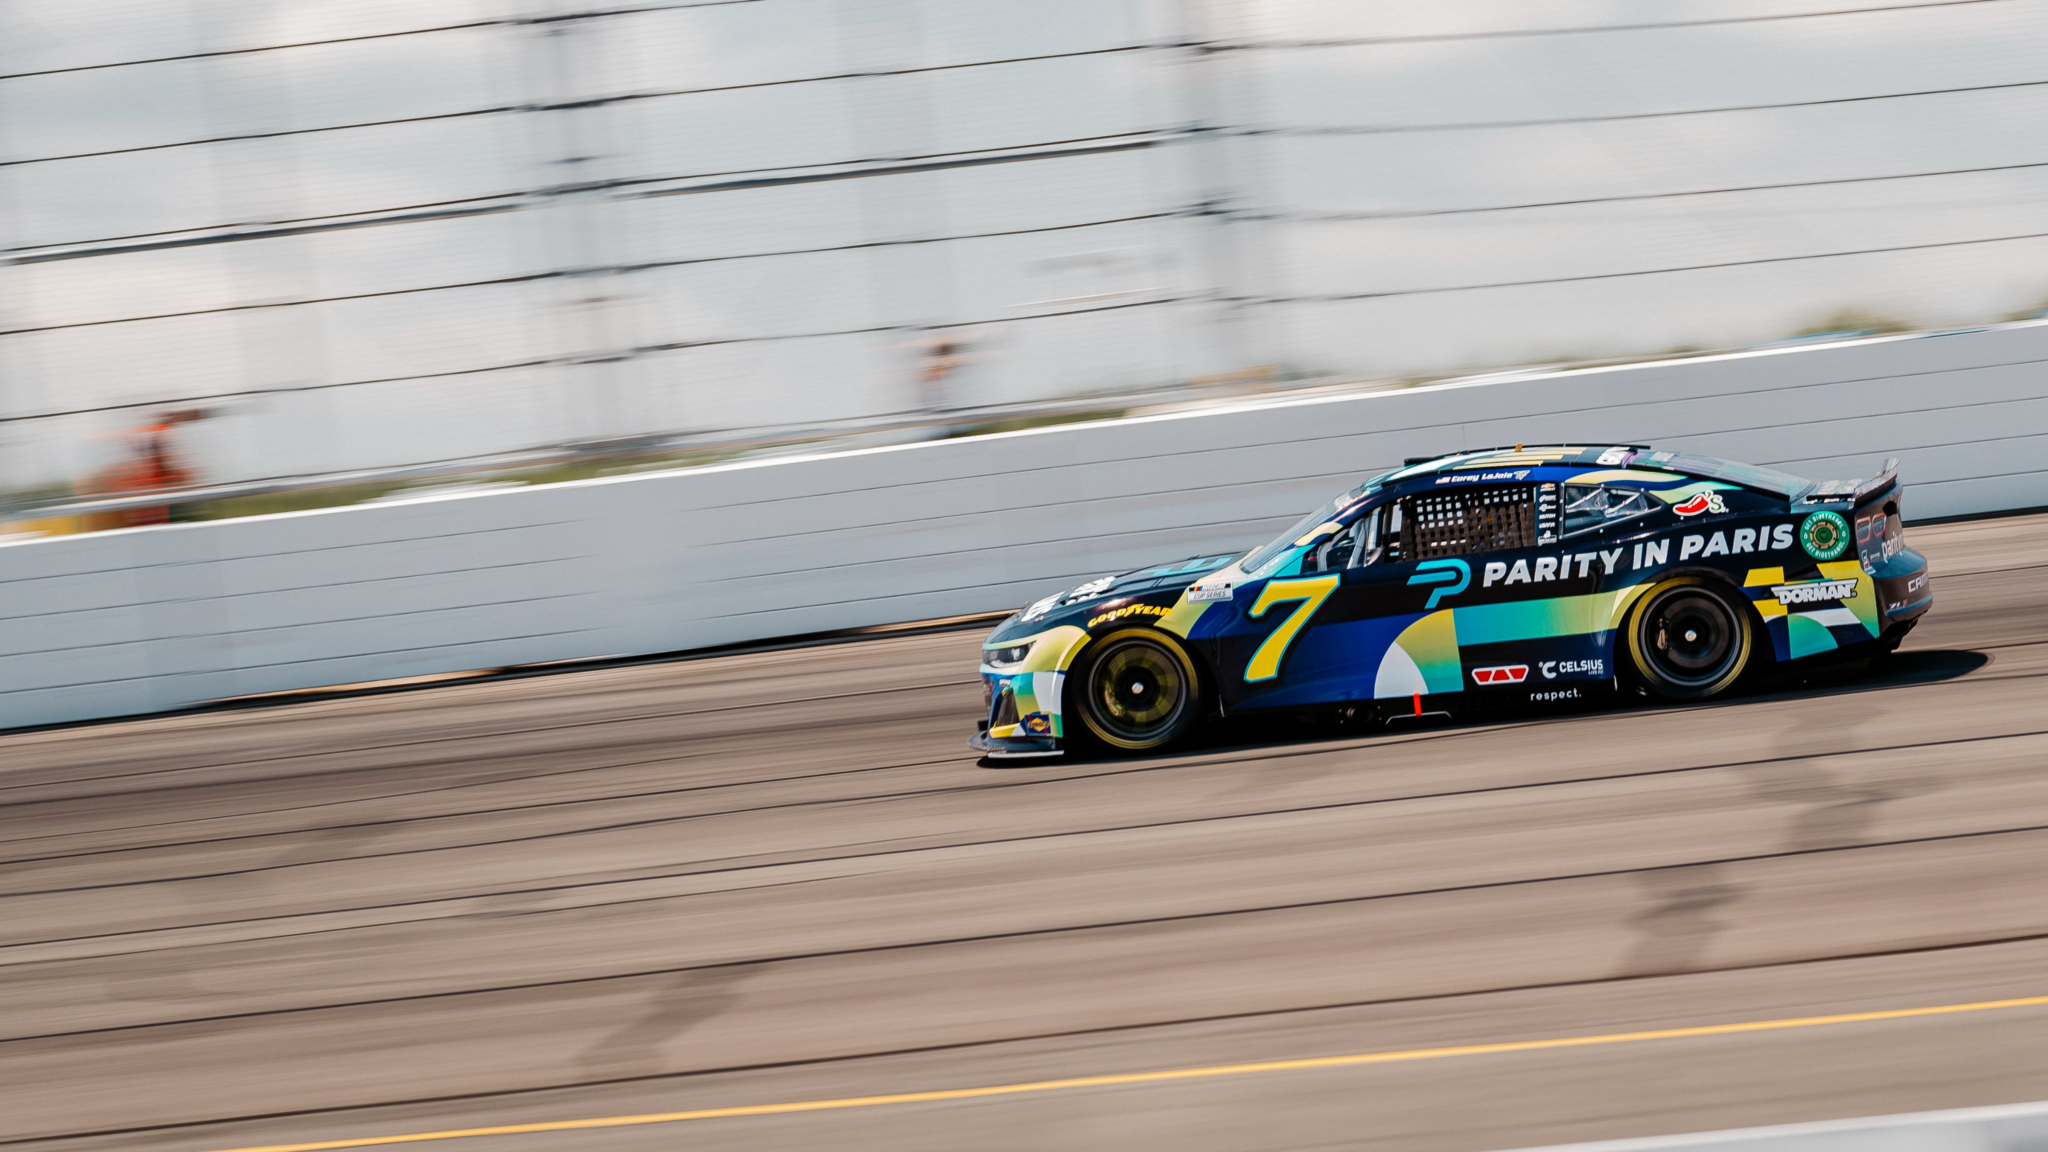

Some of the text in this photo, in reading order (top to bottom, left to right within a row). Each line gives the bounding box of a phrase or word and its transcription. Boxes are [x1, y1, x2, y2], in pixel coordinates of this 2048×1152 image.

[1451, 475, 1480, 483] Corey
[1804, 519, 1813, 531] GET
[1483, 524, 1794, 588] PARITY IN PARIS
[1806, 542, 1816, 554] GET
[1779, 583, 1852, 605] DORMAN
[1087, 603, 1173, 628] GOODYEAR
[1243, 573, 1341, 684] 7
[1559, 659, 1604, 673] CELSIUS
